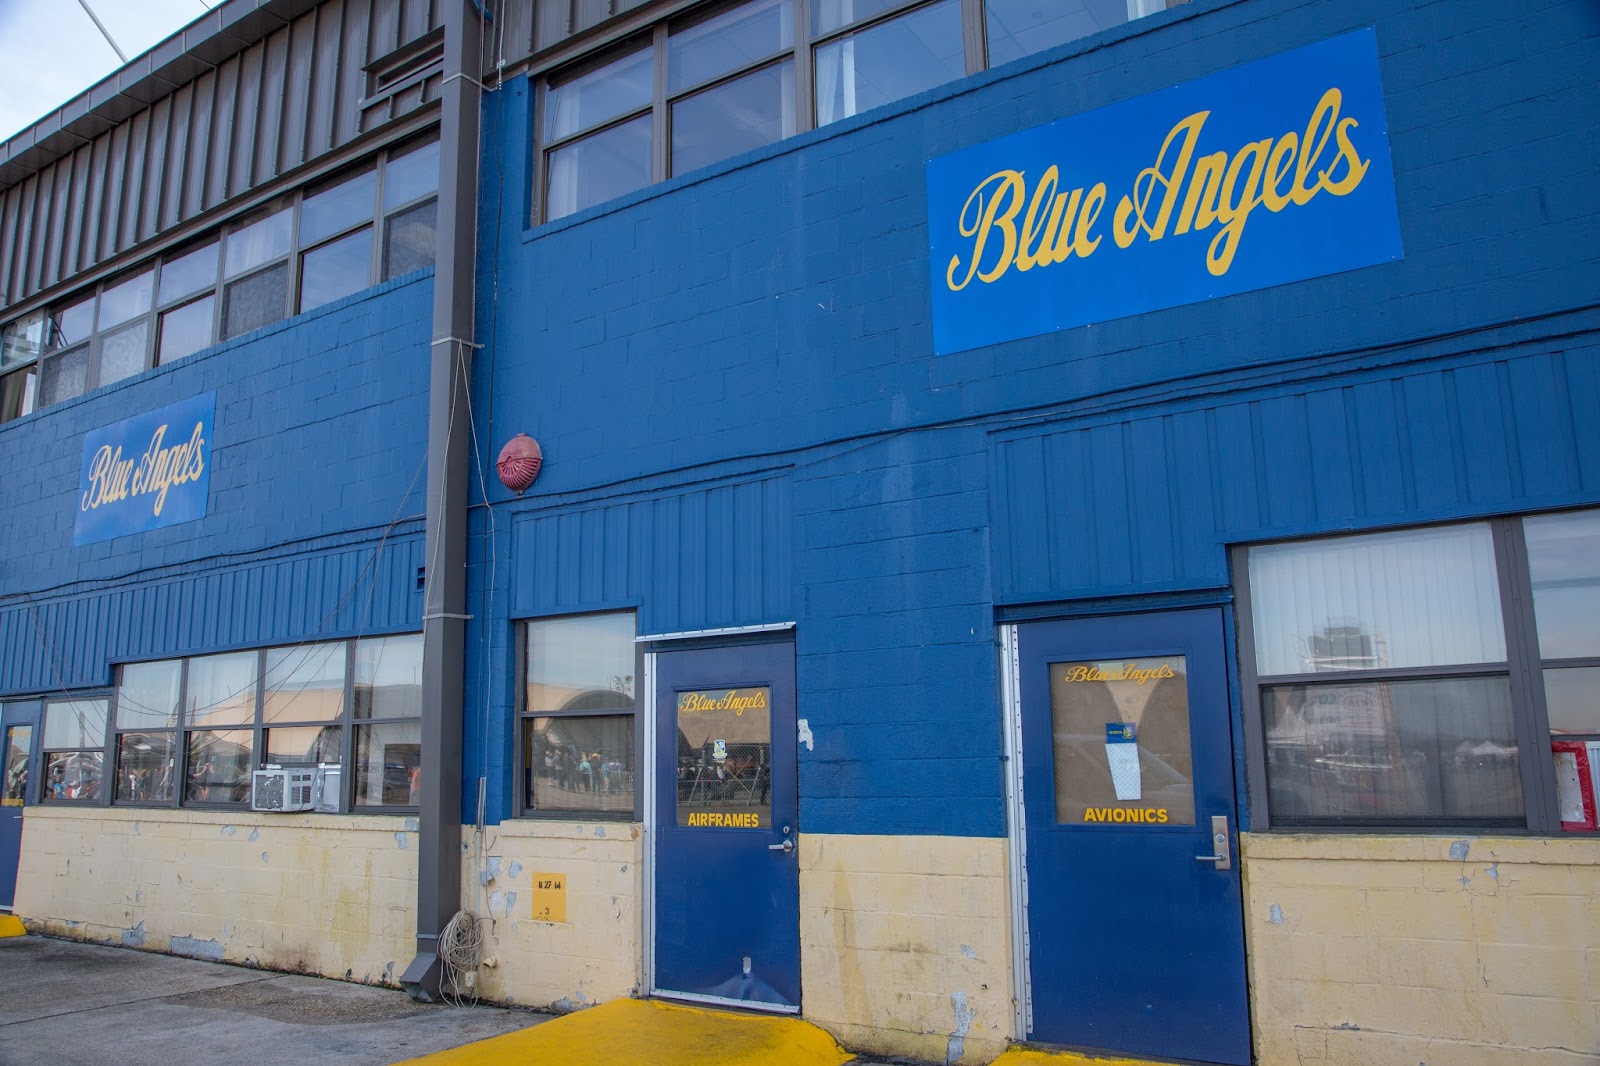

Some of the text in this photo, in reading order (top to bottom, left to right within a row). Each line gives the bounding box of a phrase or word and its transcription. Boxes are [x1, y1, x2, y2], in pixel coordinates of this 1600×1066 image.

[946, 87, 1370, 292] Blue Angels
[81, 421, 205, 517] Blue Angels
[1065, 663, 1175, 685] Blue Angels
[680, 690, 766, 716] Blue Angels
[687, 812, 759, 827] AIRFRAMES
[1083, 807, 1168, 823] AVIONICS
